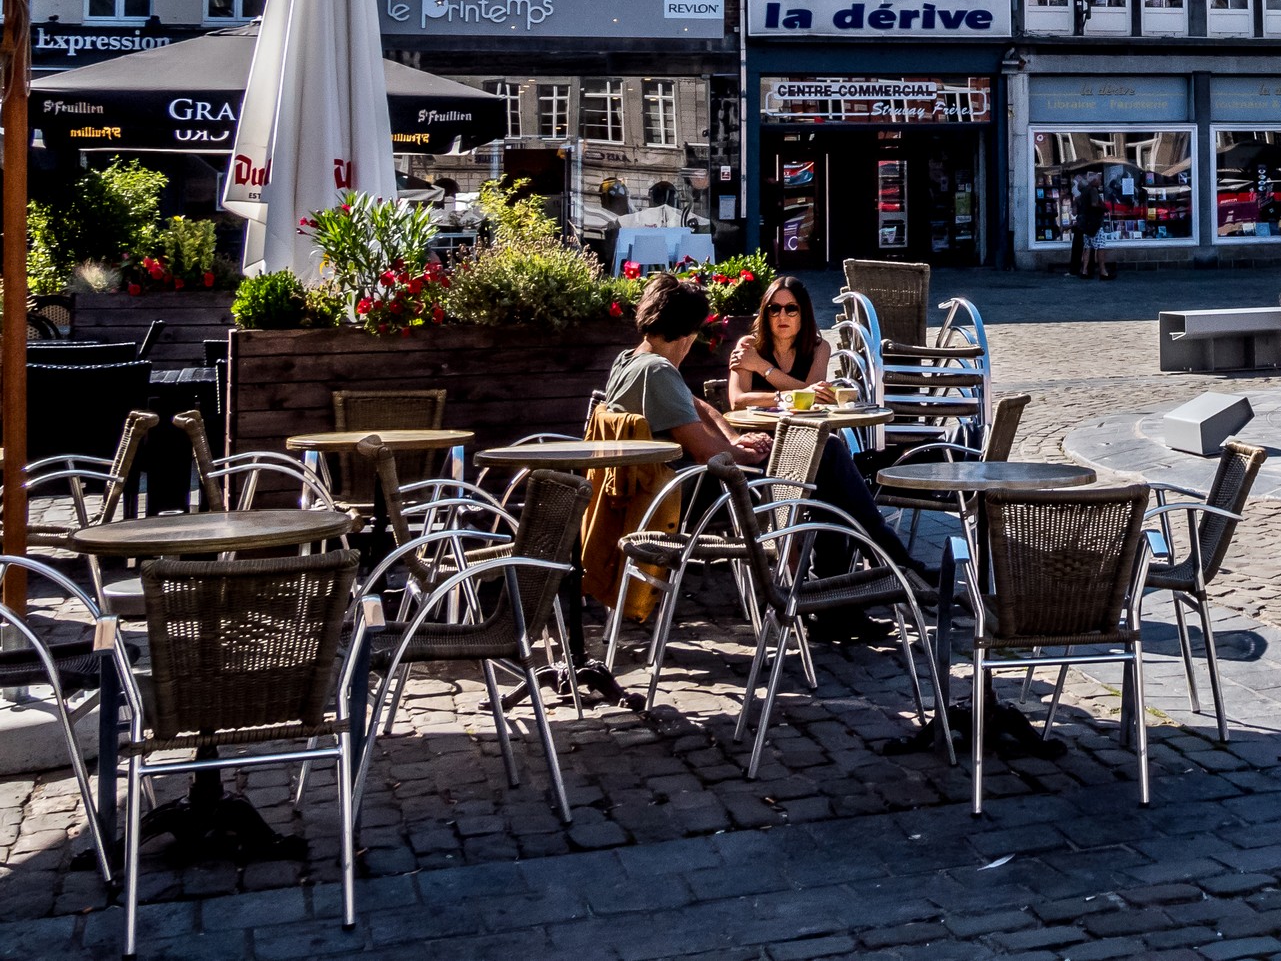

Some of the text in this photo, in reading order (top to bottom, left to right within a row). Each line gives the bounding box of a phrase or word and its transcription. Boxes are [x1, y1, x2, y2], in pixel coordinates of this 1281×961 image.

[668, 2, 719, 14] REVLON
[764, 2, 993, 30] la dérive
[777, 84, 934, 97] CENTRE COMMERCIAL
[168, 98, 237, 121] GRA
